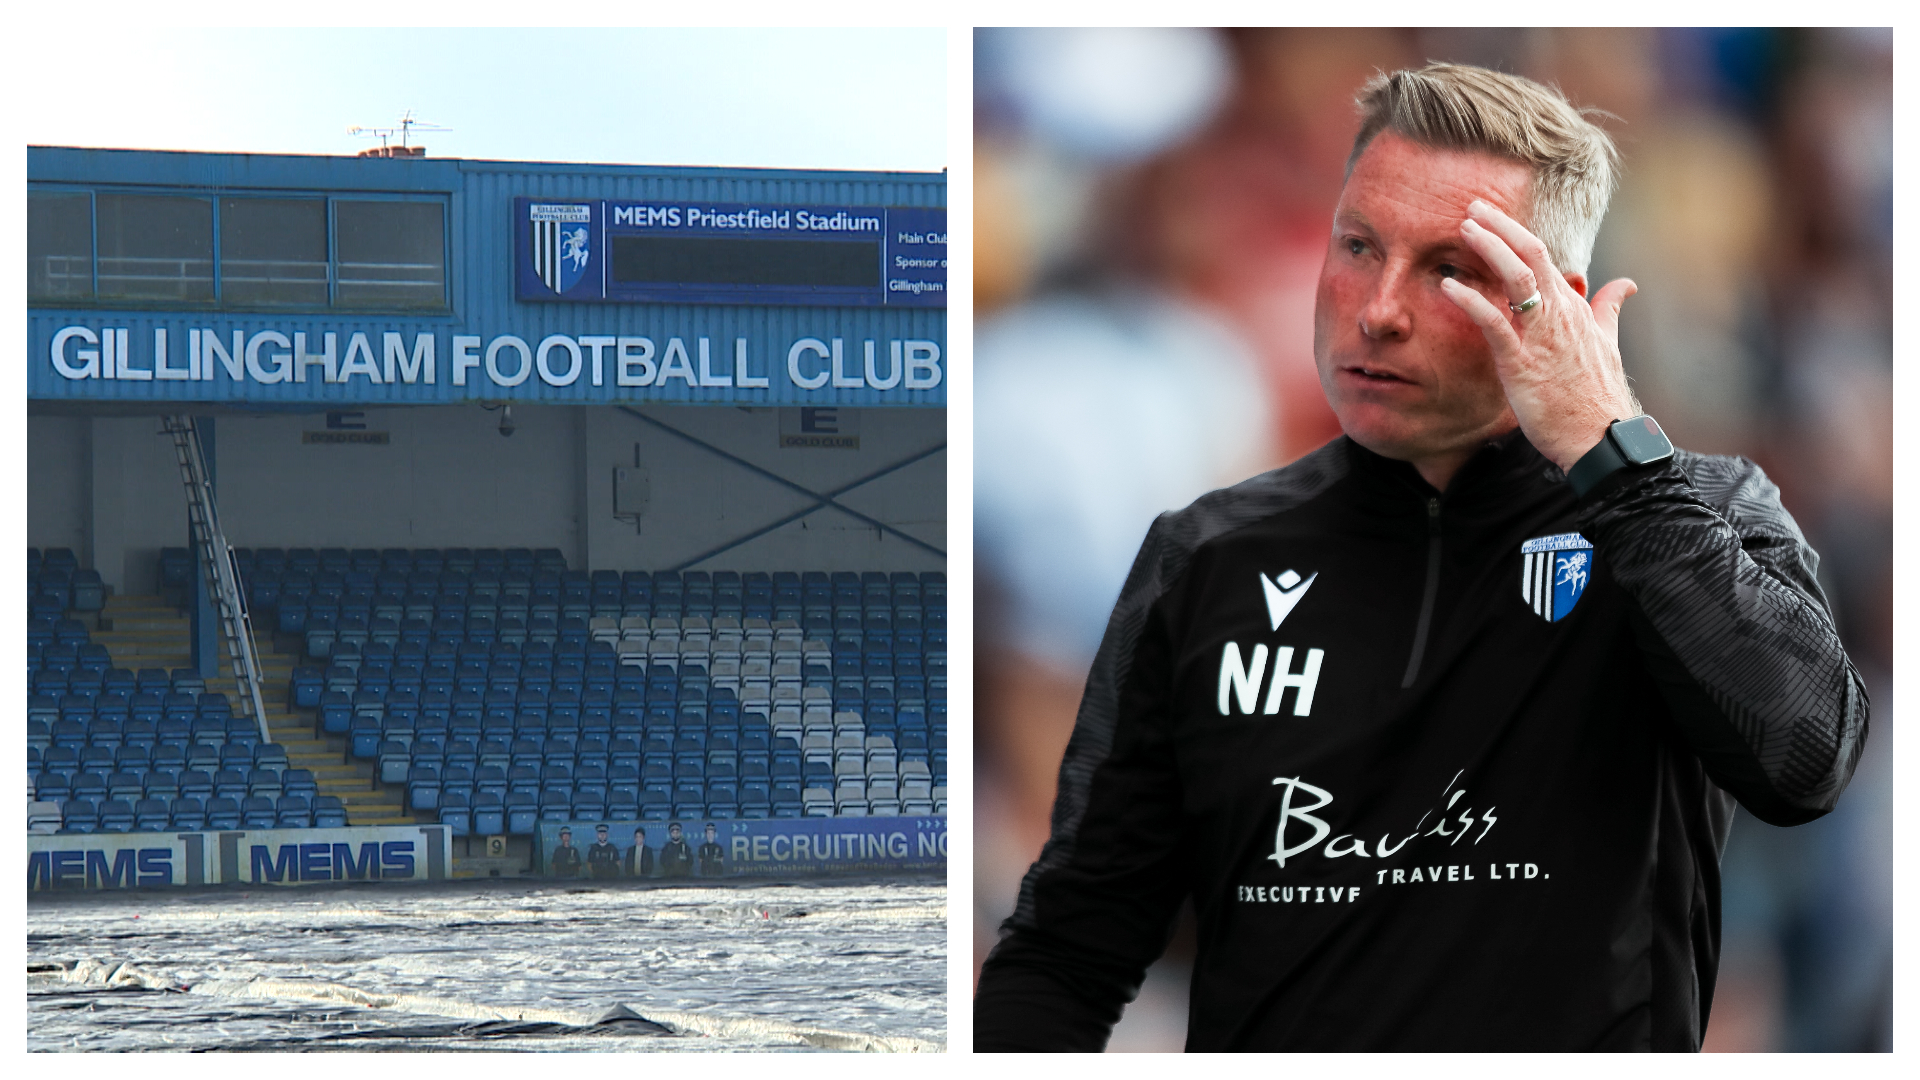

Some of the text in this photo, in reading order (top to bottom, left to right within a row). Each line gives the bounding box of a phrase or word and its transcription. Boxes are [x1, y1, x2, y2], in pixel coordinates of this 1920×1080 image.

[614, 206, 880, 232] MEMS Priestfield Stadium
[898, 232, 924, 244] Main
[895, 255, 939, 270] Sponsor
[889, 279, 943, 295] Gillingham
[50, 326, 942, 390] GILLINGHAM FOOTBALL CLUB
[801, 407, 839, 433] E
[786, 436, 854, 447] GOLD CLUB
[1217, 641, 1325, 717] NH
[492, 839, 502, 854] 9
[731, 832, 908, 862] RECRUITING
[27, 848, 173, 889] MEMS
[250, 841, 415, 884] MEMS
[1376, 865, 1475, 885] TRAVEL
[1490, 863, 1550, 880] LTD.
